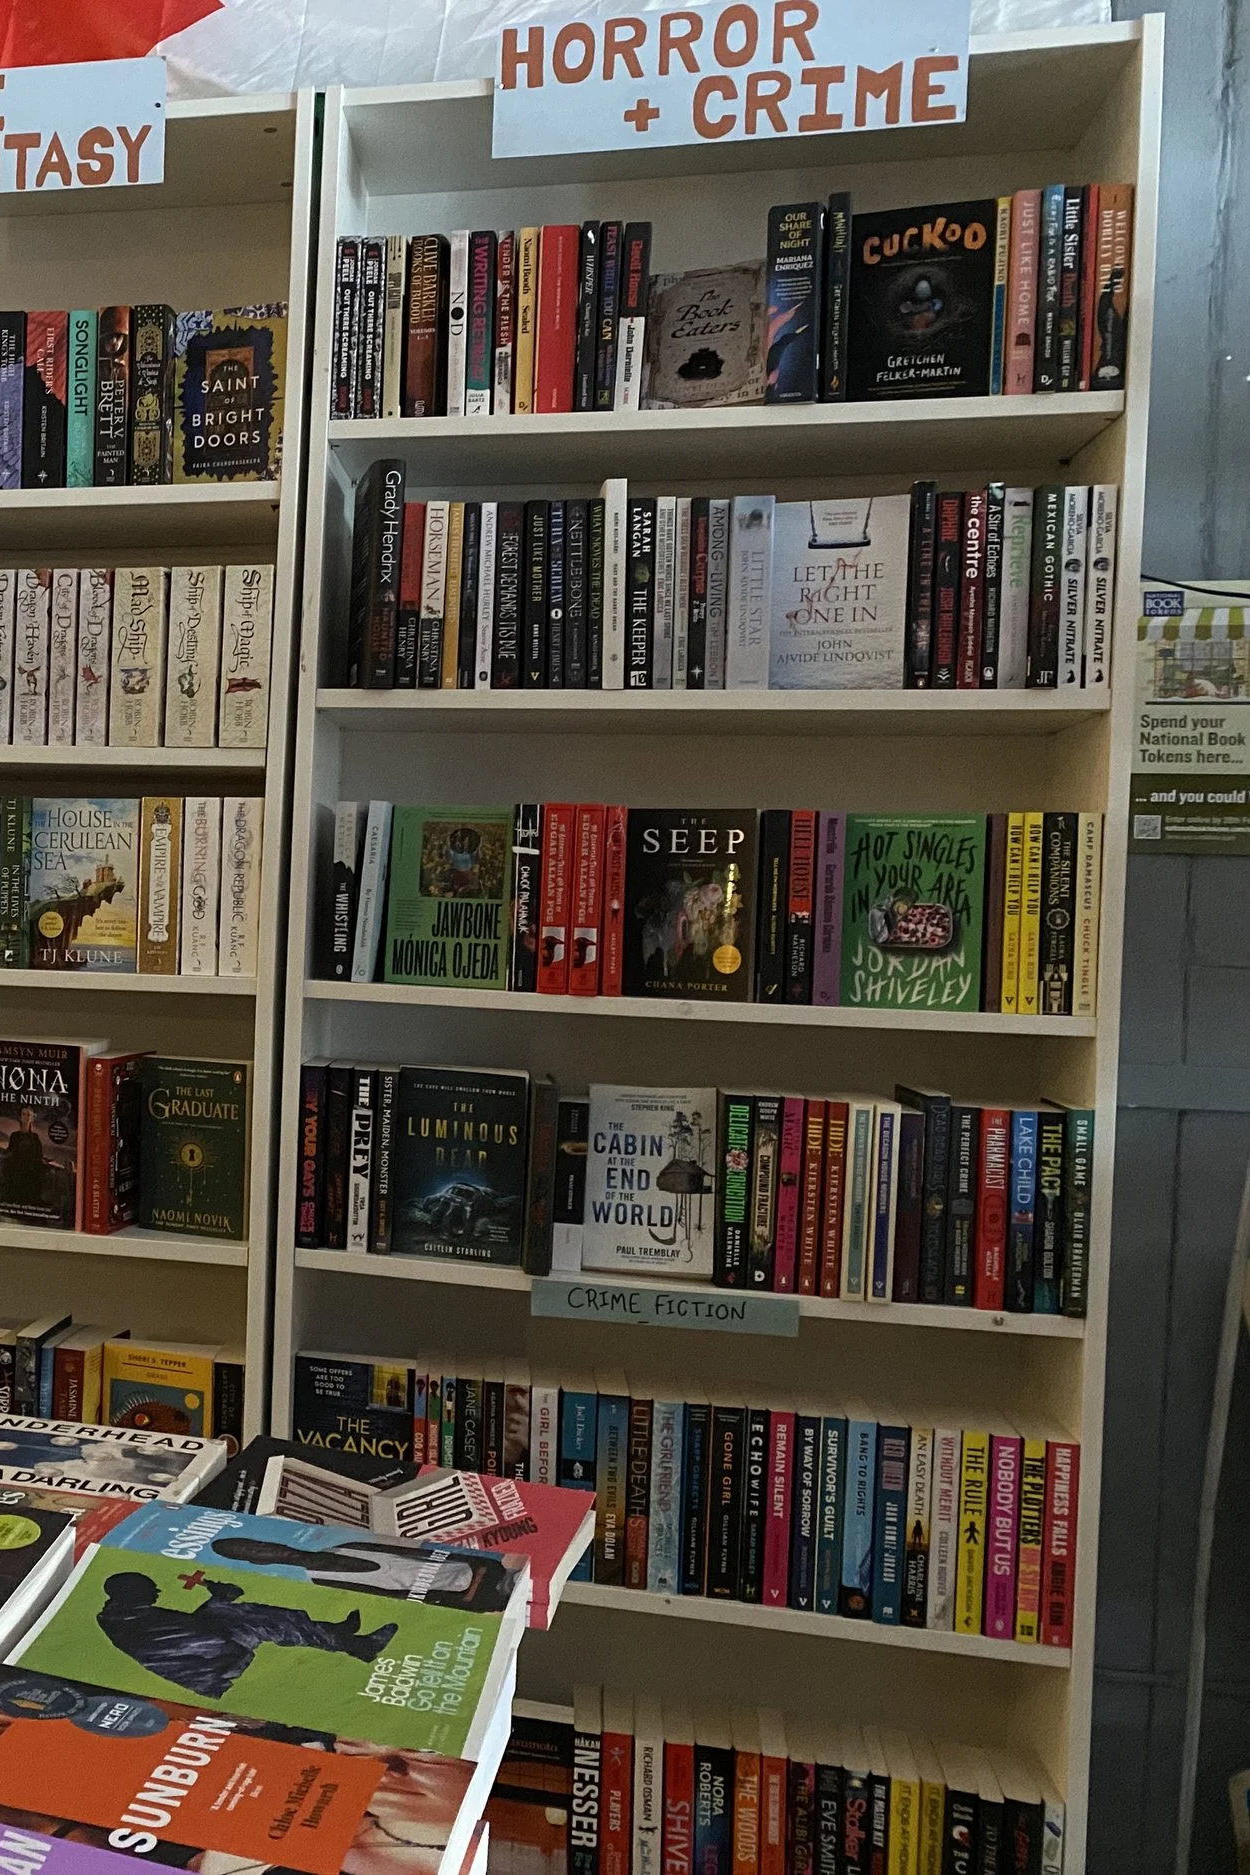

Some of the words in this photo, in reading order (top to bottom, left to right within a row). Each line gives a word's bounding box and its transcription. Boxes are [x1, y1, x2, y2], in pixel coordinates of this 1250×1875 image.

[501, 0, 820, 89] HORROR
[624, 98, 660, 132] +
[692, 54, 959, 140] CRIME
[779, 221, 812, 232] SHARE
[785, 212, 808, 221] OUR
[779, 239, 810, 249] NIGHT
[862, 216, 987, 265] CUCKOO
[775, 262, 814, 272] ENRIQUEZ
[776, 255, 813, 264] MARIANA
[676, 300, 735, 322] Book
[671, 319, 741, 340] Eaters
[74, 320, 88, 416] SONGLIGHT
[223, 365, 239, 373] THE
[887, 353, 945, 368] GRETCHEN
[200, 376, 260, 394] SAINT
[876, 367, 961, 383] FELKER-MARTIN
[192, 408, 265, 427] BRIGHT
[194, 430, 262, 449] DOORS
[379, 470, 401, 519] Grady
[970, 495, 982, 515] the
[632, 507, 642, 558] LANGAN
[643, 511, 652, 552] SARAH
[1046, 493, 1057, 550] MEXICAN
[381, 522, 399, 583] Hendrix
[426, 508, 445, 601] HORSEMAN
[965, 517, 982, 579] centre
[793, 566, 833, 583] LET
[838, 563, 884, 580] THE
[1044, 555, 1055, 601] GOTHIC
[800, 584, 878, 604] RIGHT
[1067, 578, 1078, 616] SILVER
[1145, 599, 1183, 608] BOOK
[794, 608, 845, 625] ONE
[851, 606, 878, 621] IN
[1145, 607, 1183, 616] tokens
[817, 640, 853, 650] JOHN
[1065, 620, 1076, 665] NITRATE
[1140, 714, 1187, 731] Spend
[1191, 717, 1226, 732] your
[1139, 731, 1203, 746] National
[1208, 731, 1246, 746] Book
[1140, 749, 1191, 763] Tokens
[1196, 749, 1243, 764] here...
[1150, 790, 1175, 802] and
[1179, 791, 1203, 804] you
[1207, 790, 1246, 802] could
[48, 807, 113, 829] HOUSE
[35, 831, 132, 852] CERULEAN
[642, 829, 745, 854] SEEP
[35, 851, 67, 871] SEA
[850, 831, 900, 881] HOT
[903, 830, 978, 875] SINGLES
[432, 901, 503, 940] JAWBONE
[40, 948, 57, 963] TJ
[64, 949, 123, 964] KLUNE
[392, 933, 447, 979] MÓNICA
[452, 944, 499, 981] OJEDA
[850, 971, 973, 1006] SHIVELEY
[20, 1094, 60, 1107] NINTH
[176, 1086, 196, 1096] THE
[199, 1087, 214, 1098] LAST
[149, 1088, 239, 1121] GRADUATE
[408, 1117, 518, 1146] LUMINOUS
[608, 1122, 624, 1131] THE
[352, 1111, 371, 1180] PREY
[593, 1132, 663, 1157] CABIN
[606, 1167, 651, 1191] END
[152, 1208, 190, 1226] NAOMI
[194, 1215, 235, 1232] NOVIK
[592, 1201, 674, 1228] WORLD
[616, 1246, 636, 1256] PAUL
[639, 1246, 681, 1258] TREMBLAY
[568, 1286, 641, 1314] CRIME
[655, 1294, 746, 1320] FICTION
[336, 1416, 370, 1435] THE
[296, 1429, 410, 1462] VACANCY
[10, 1471, 160, 1499] DARLING
[441, 1628, 483, 1691] Mountain
[358, 1657, 396, 1702] James
[381, 1654, 423, 1707] Baldwin
[407, 1690, 436, 1711] Go
[432, 1641, 454, 1659] on
[432, 1693, 462, 1716] the
[108, 1716, 238, 1853] SUNBURN
[699, 1761, 712, 1827] ROBERTS
[571, 1749, 600, 1849] NESSER
